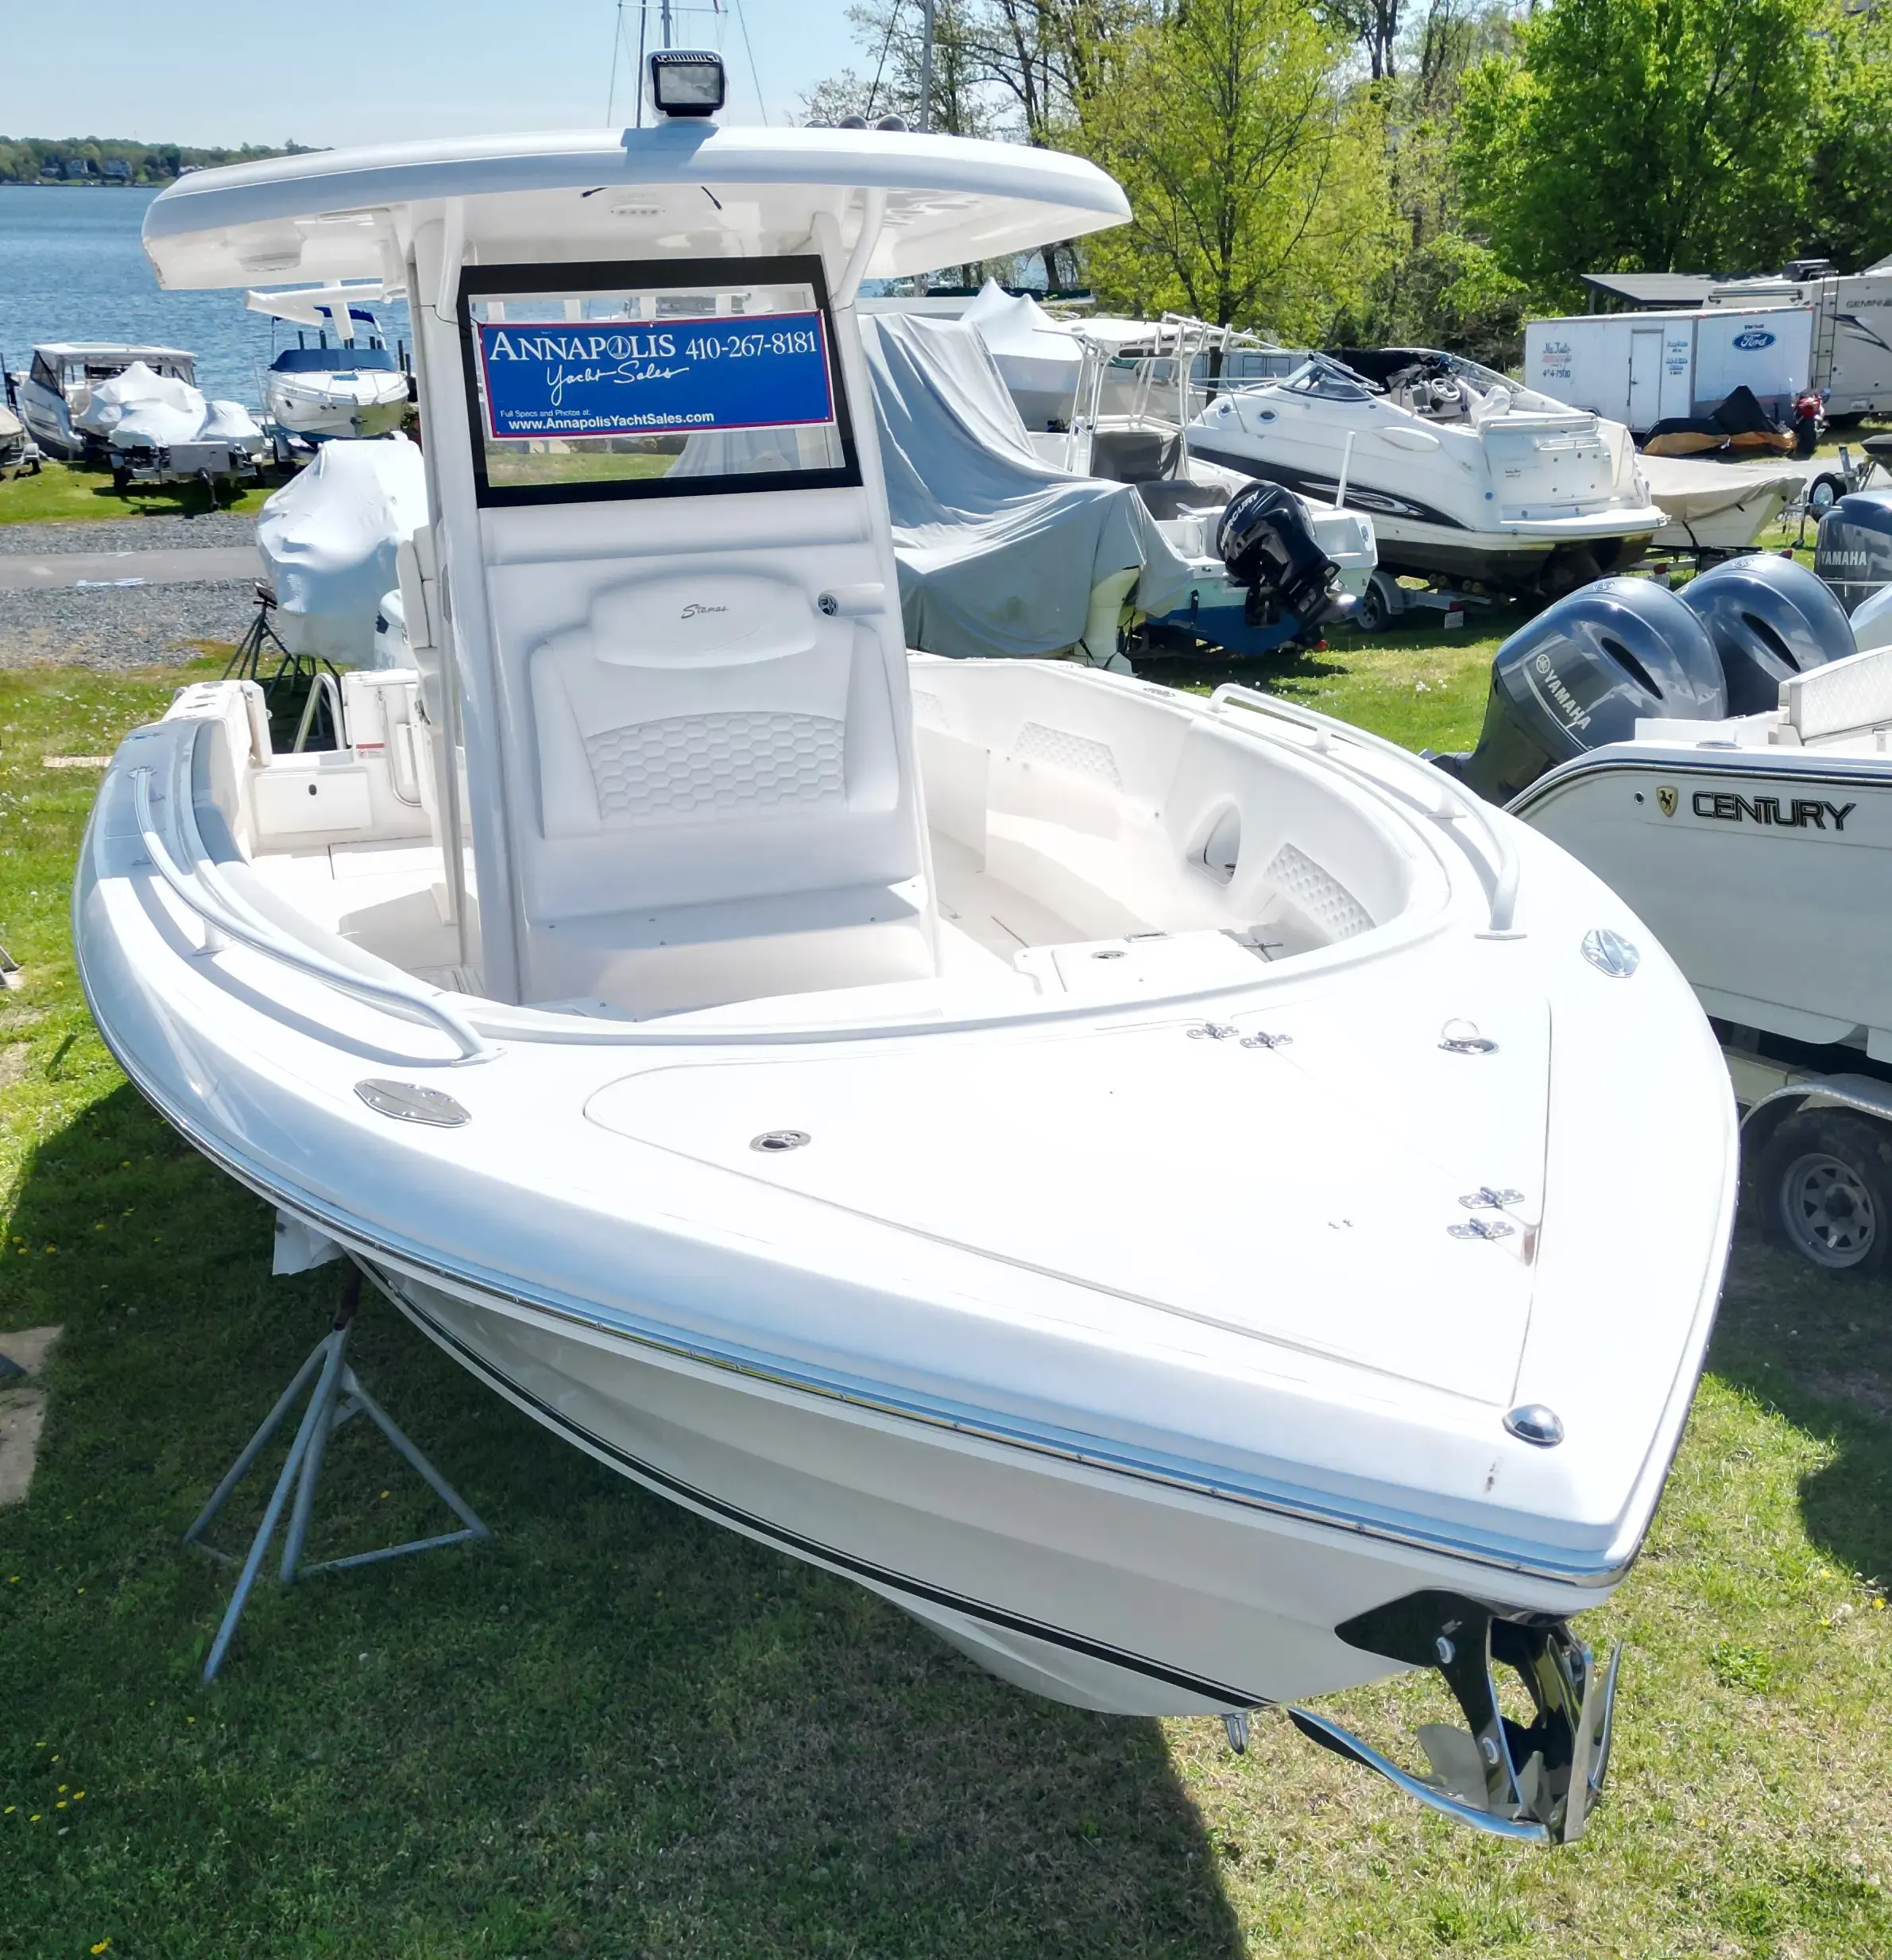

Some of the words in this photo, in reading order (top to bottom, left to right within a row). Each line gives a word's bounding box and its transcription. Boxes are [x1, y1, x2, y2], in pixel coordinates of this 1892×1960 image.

[685, 331, 817, 360] 410-267-8181
[1740, 333, 1768, 347] Ford
[546, 364, 617, 406] Yacht
[613, 360, 690, 384] Sales
[509, 413, 714, 430] www.AnnapolisYachtSales.com
[1821, 551, 1867, 566] YAMAHA
[1545, 668, 1592, 730] YAMAHA
[1693, 791, 1856, 831] CENTURY
